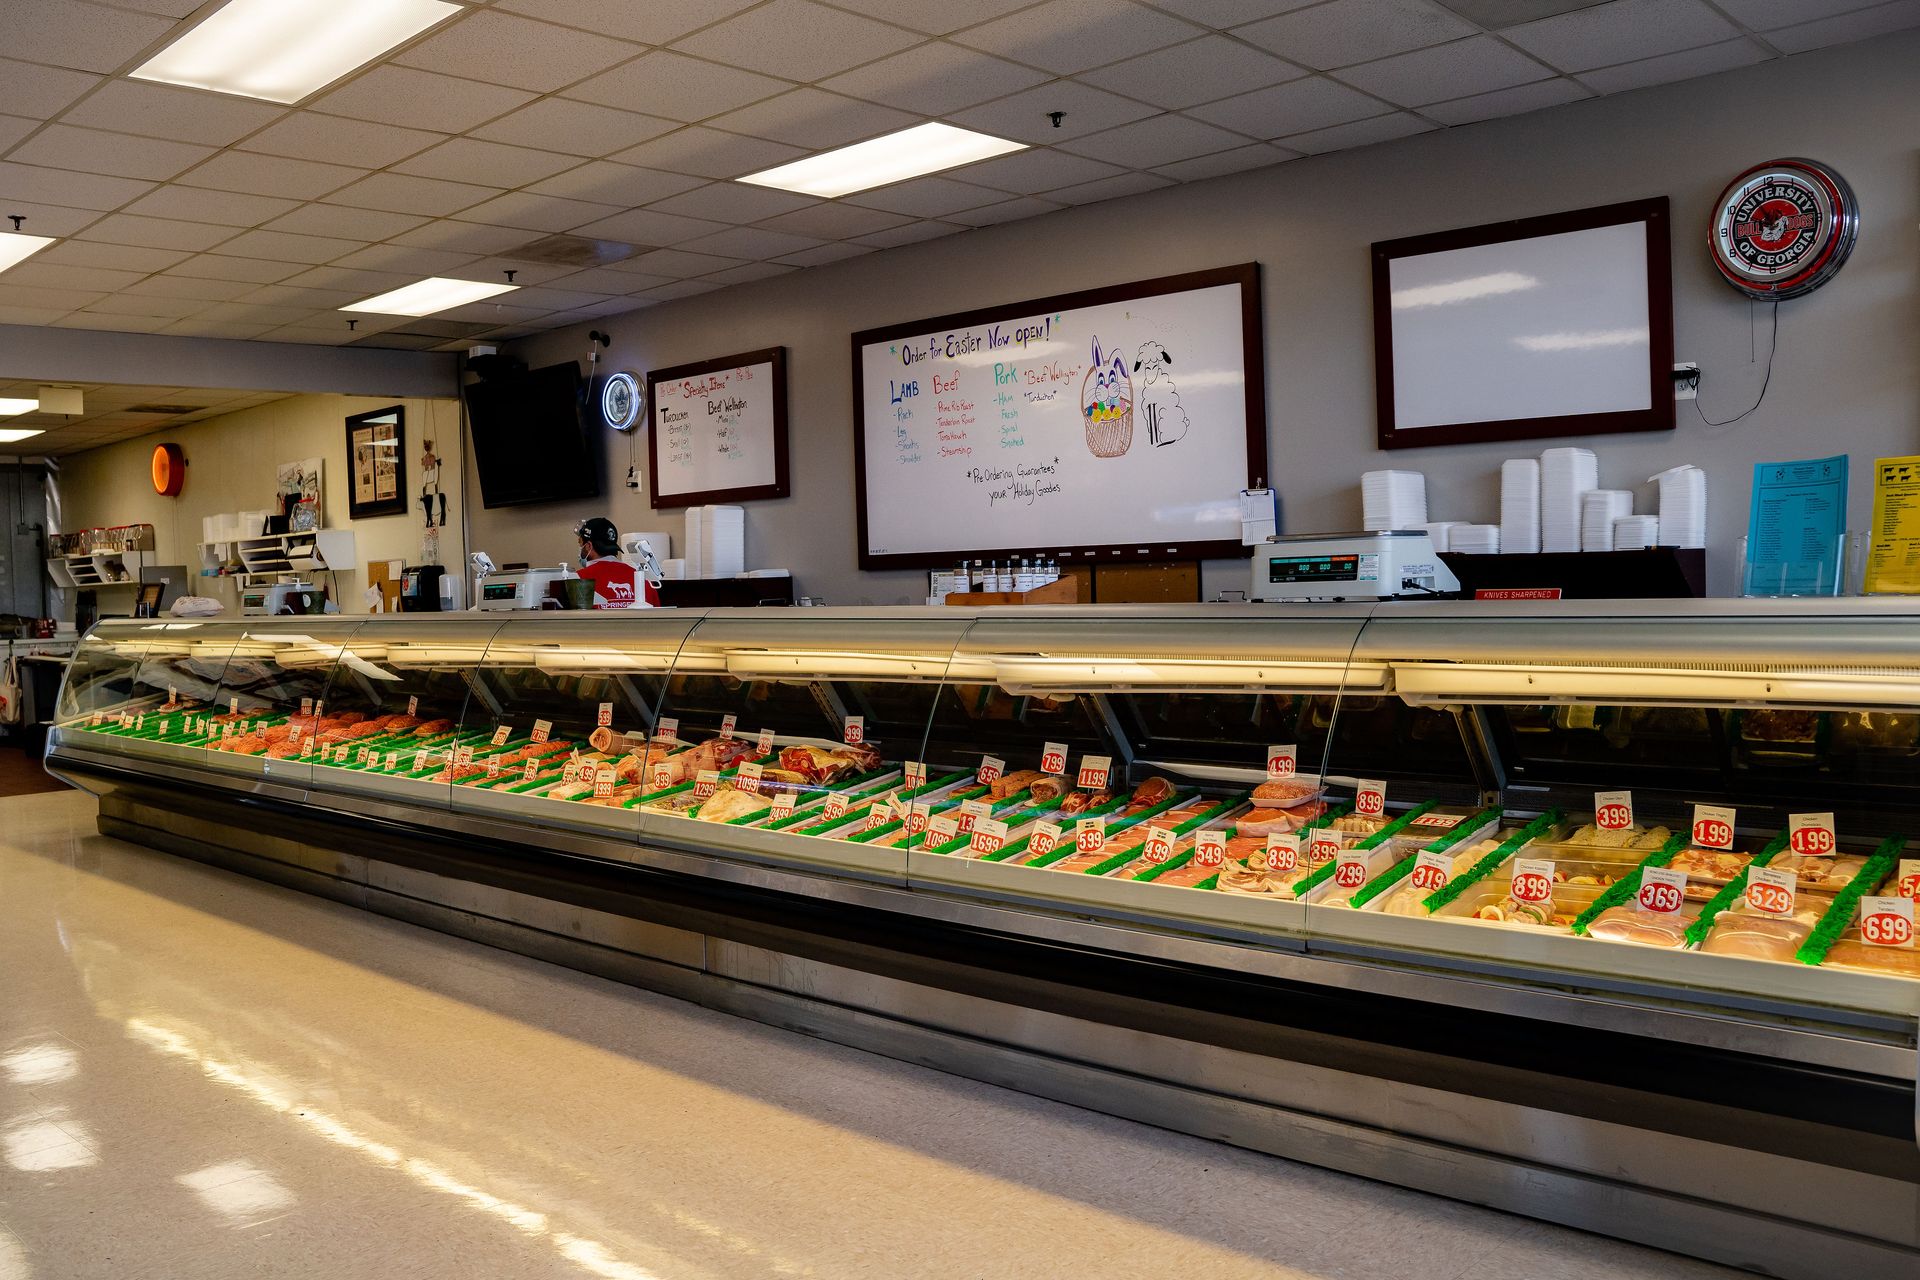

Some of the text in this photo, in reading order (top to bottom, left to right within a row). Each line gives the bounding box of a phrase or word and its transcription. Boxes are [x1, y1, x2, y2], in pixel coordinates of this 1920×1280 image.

[1736, 186, 1814, 222] UNIVERSITY
[1737, 222, 1762, 238] BULL
[1739, 231, 1814, 265] OF GEORGIA
[902, 344, 927, 366] Order
[930, 337, 942, 360] for
[945, 331, 981, 358] Easter
[988, 325, 1010, 350] Now
[933, 369, 960, 395] Beef
[994, 362, 1018, 386] Pork
[890, 380, 920, 404] LAMB
[984, 465, 1015, 490] Ordering
[1016, 461, 1055, 478] Guarantees
[1483, 590, 1552, 599] KNIVES SHARPENED
